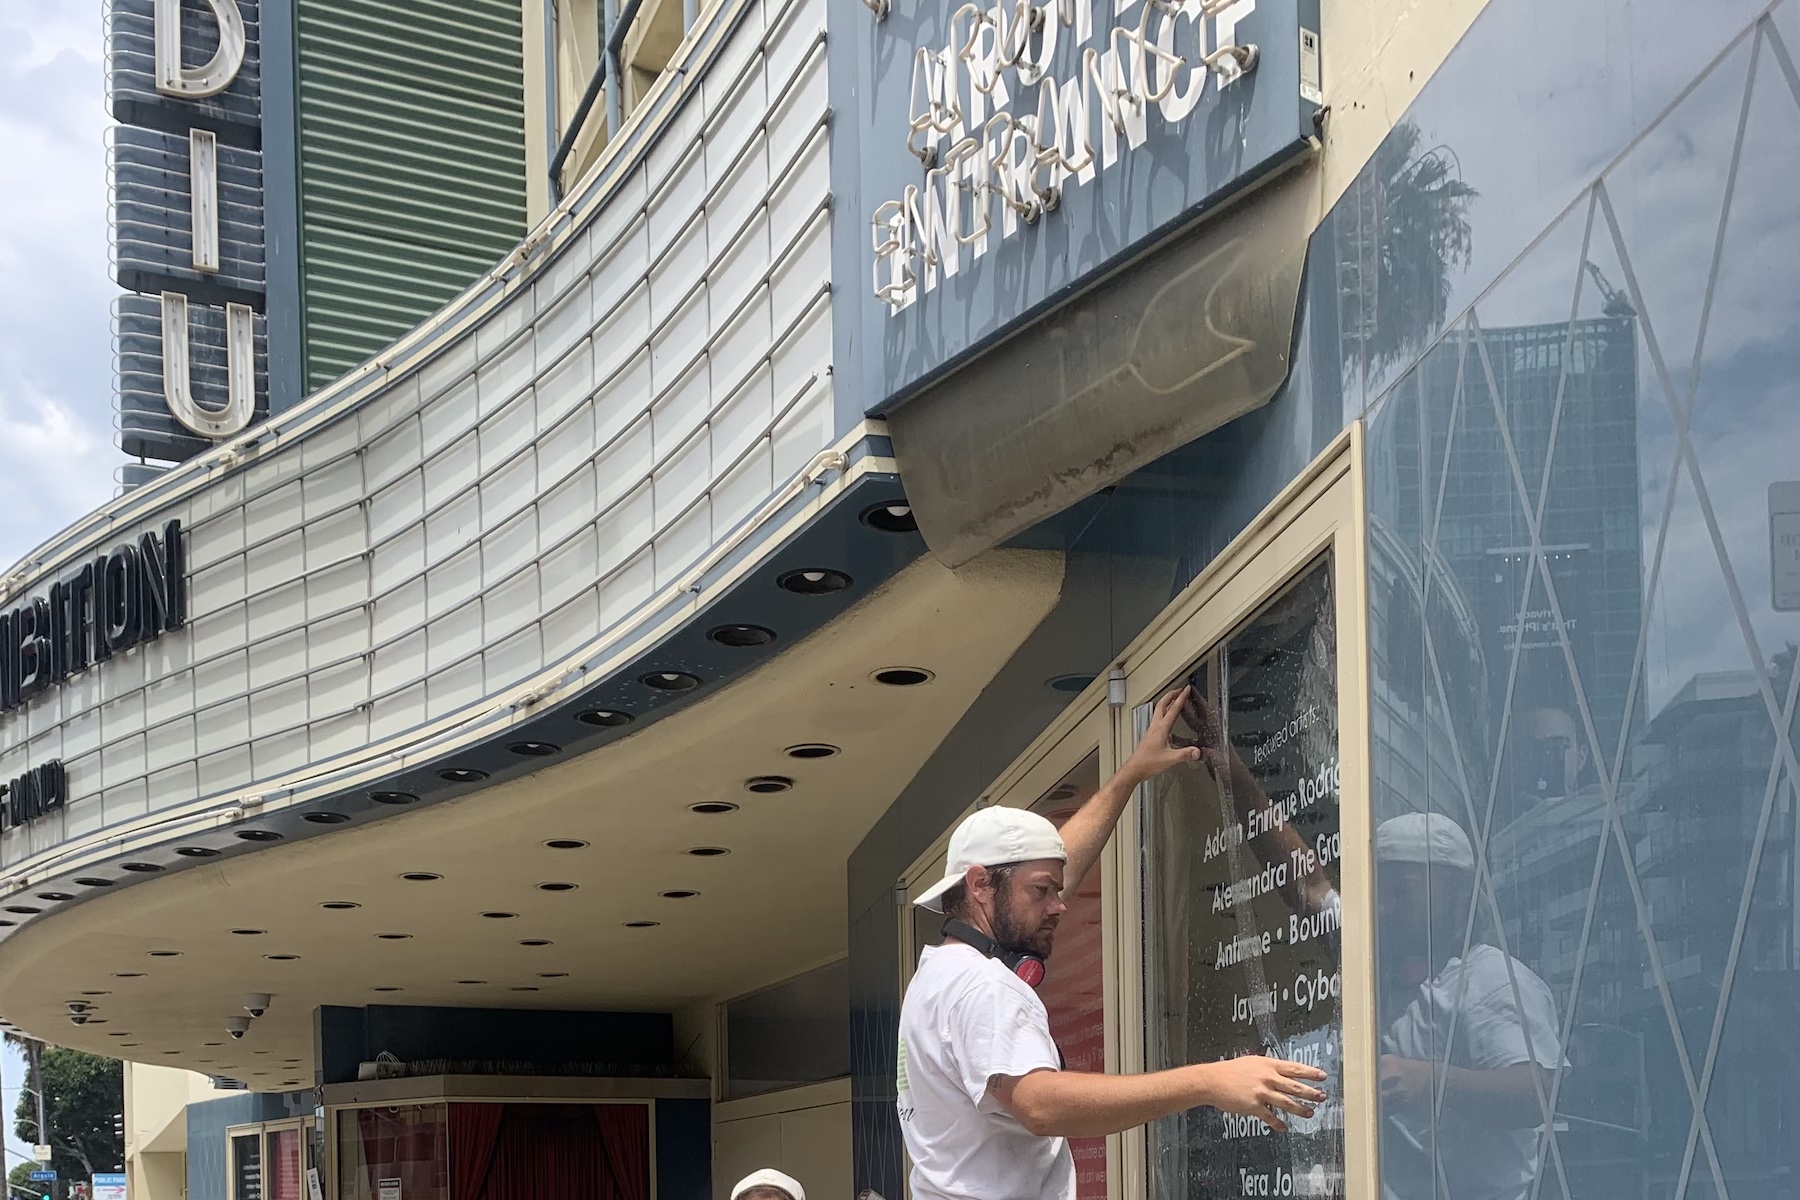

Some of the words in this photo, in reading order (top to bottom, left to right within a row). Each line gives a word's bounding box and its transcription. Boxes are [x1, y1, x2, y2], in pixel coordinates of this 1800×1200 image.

[1247, 792, 1297, 841] Enrique
[1290, 848, 1315, 881] The
[1239, 1167, 1269, 1197] Tera
